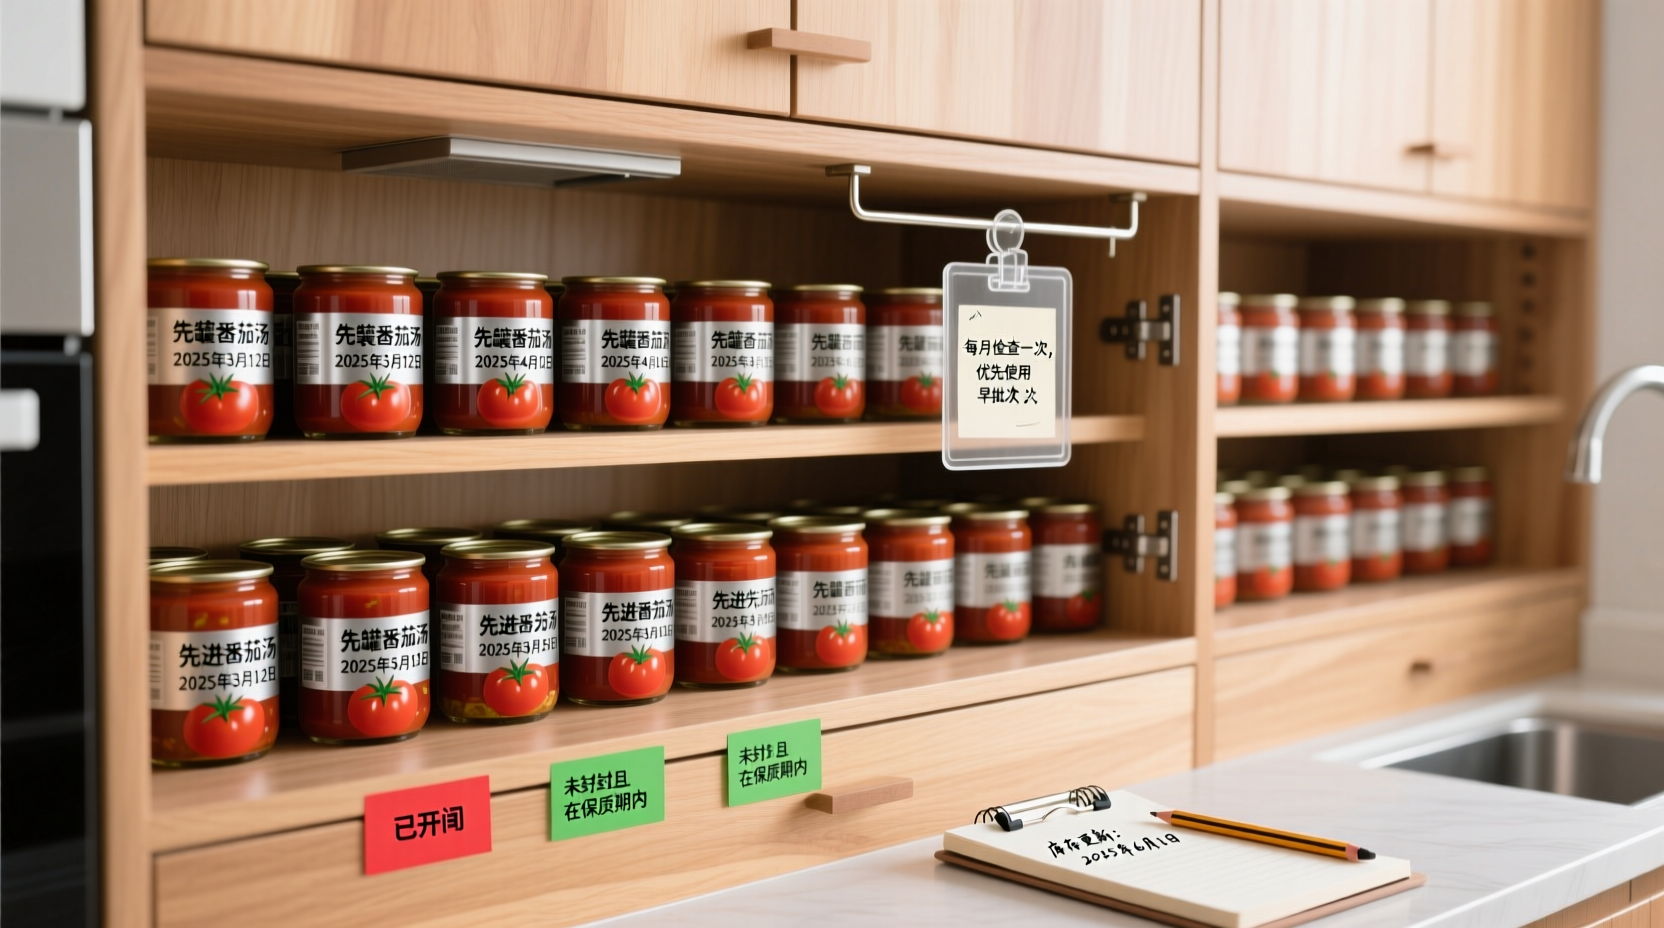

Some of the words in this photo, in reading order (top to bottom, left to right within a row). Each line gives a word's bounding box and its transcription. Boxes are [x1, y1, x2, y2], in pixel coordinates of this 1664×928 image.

[173, 351, 271, 369] 2025年3月12日
[976, 363, 1031, 381] 优先使用
[179, 636, 277, 668] 先进番茄汤
[179, 665, 277, 691] 2025年3月12日
[564, 789, 648, 822] 在保质期内
